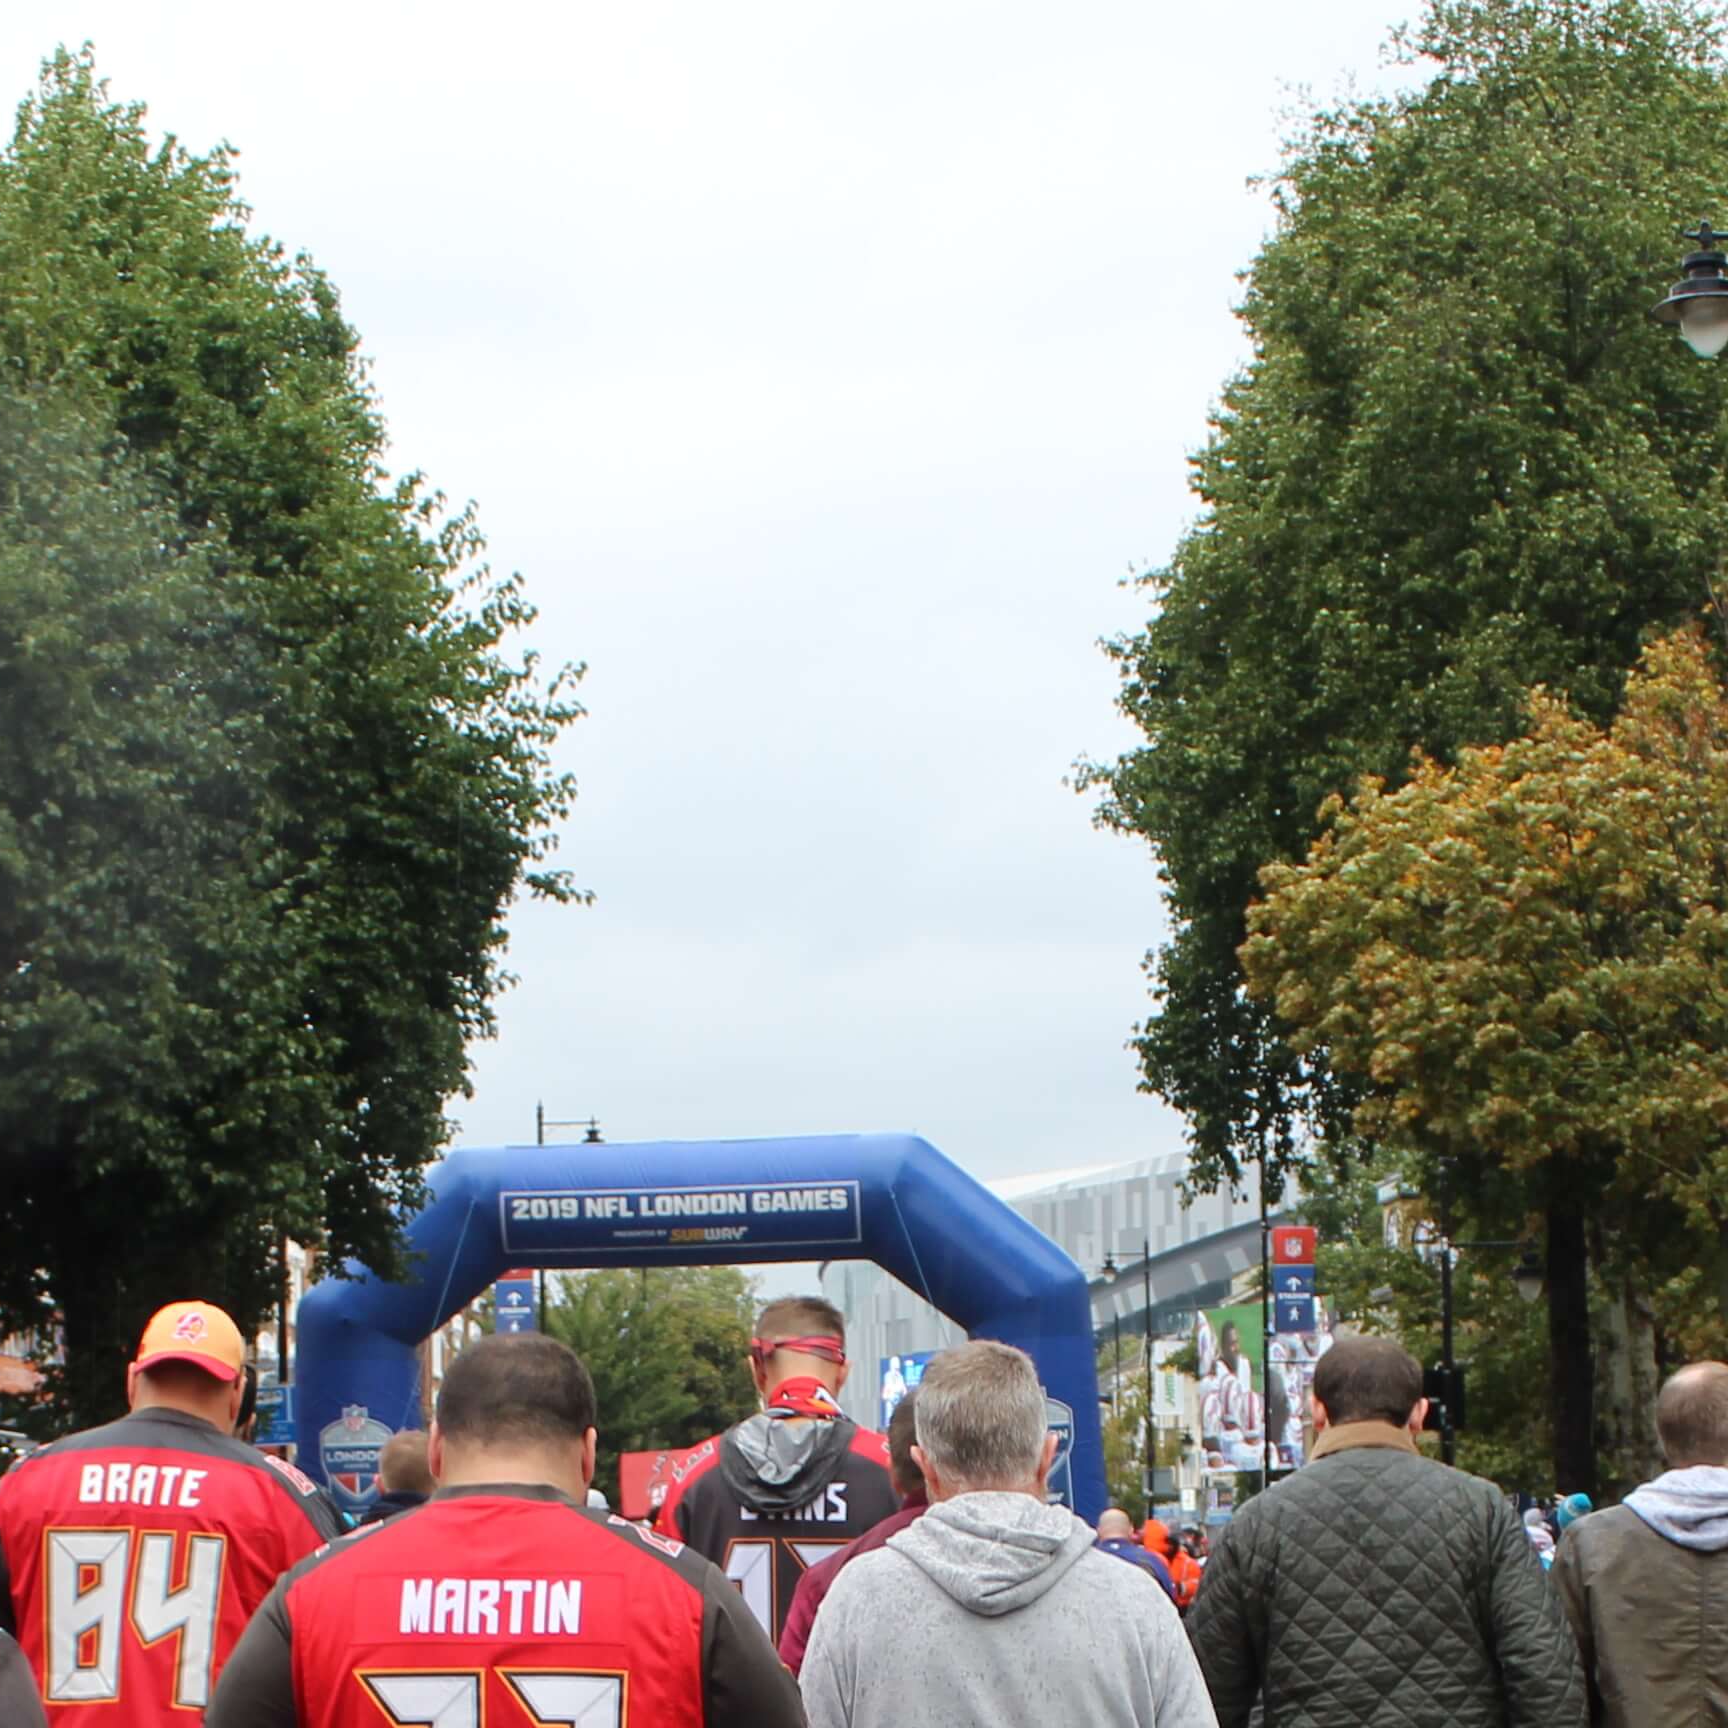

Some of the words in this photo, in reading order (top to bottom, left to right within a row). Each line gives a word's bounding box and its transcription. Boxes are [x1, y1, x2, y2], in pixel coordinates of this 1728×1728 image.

[511, 1198, 578, 1221] 2019
[584, 1197, 635, 1219] NFL
[640, 1193, 746, 1217] LONDON
[752, 1188, 848, 1213] GAMES
[669, 1226, 749, 1242] SUBWAY
[326, 1449, 380, 1463] LONDO
[78, 1462, 208, 1508] BRATE
[42, 1526, 228, 1711] 84
[398, 1577, 582, 1636] MARTIN
